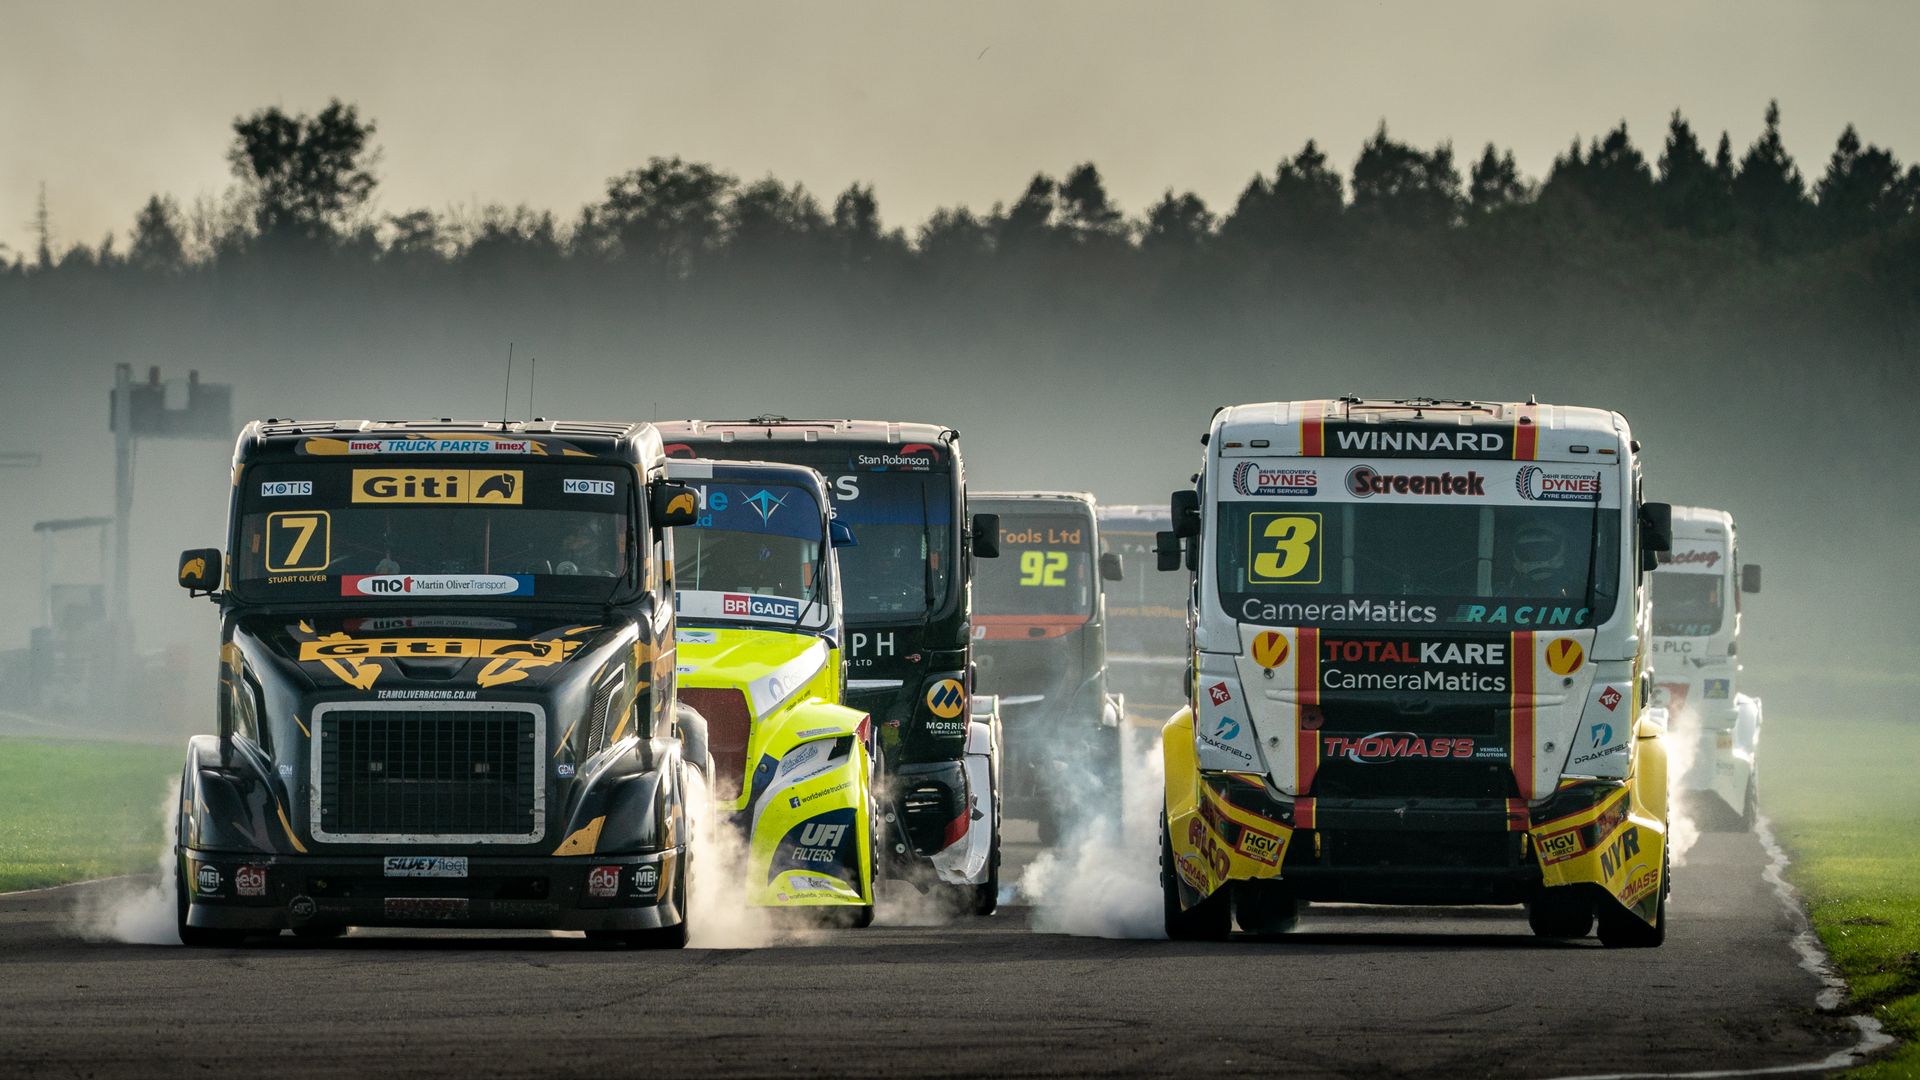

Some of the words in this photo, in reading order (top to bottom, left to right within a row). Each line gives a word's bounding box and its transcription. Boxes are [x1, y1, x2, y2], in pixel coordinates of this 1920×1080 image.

[351, 441, 382, 451] imex
[388, 441, 436, 451] TRUCK
[440, 441, 489, 451] PARTS
[495, 441, 526, 451] imex
[1337, 431, 1503, 451] WINNARD
[858, 454, 880, 464] Stan
[882, 455, 929, 465] Robinson
[363, 475, 458, 498] Giti
[565, 481, 613, 494] MOTIS
[1259, 475, 1317, 486] DYNES
[1355, 470, 1485, 496] Screentek
[1542, 479, 1602, 491] DYNES
[263, 482, 311, 495] MOTIS
[282, 517, 318, 565] 7
[1048, 528, 1080, 544] Ltd
[1254, 517, 1317, 578] 3
[1020, 551, 1068, 586] 92
[268, 576, 298, 584] STUART
[299, 575, 327, 583] OLIVER
[372, 576, 414, 592] mot
[417, 579, 444, 590] Martin
[725, 598, 795, 617] BRIGADE
[1243, 599, 1436, 622] CameraMatics
[316, 641, 462, 655] Giti
[1324, 640, 1505, 665] TOTALKARE
[1664, 641, 1692, 653] PLC
[1324, 669, 1505, 691] CameraMatics
[377, 690, 477, 699] TEAMOLIVERRACING.CO.UK
[926, 722, 965, 730] MORRIS
[1324, 737, 1475, 758] THOMAS'S
[558, 764, 575, 775] GDM
[800, 823, 846, 847] UFI
[1245, 832, 1277, 851] HGV
[1543, 833, 1575, 852] HGV
[792, 848, 835, 863] FILTERS
[1552, 846, 1575, 857] DIRECT
[1600, 826, 1640, 884] NYR
[200, 871, 220, 883] MEI
[636, 871, 656, 882] MEI
